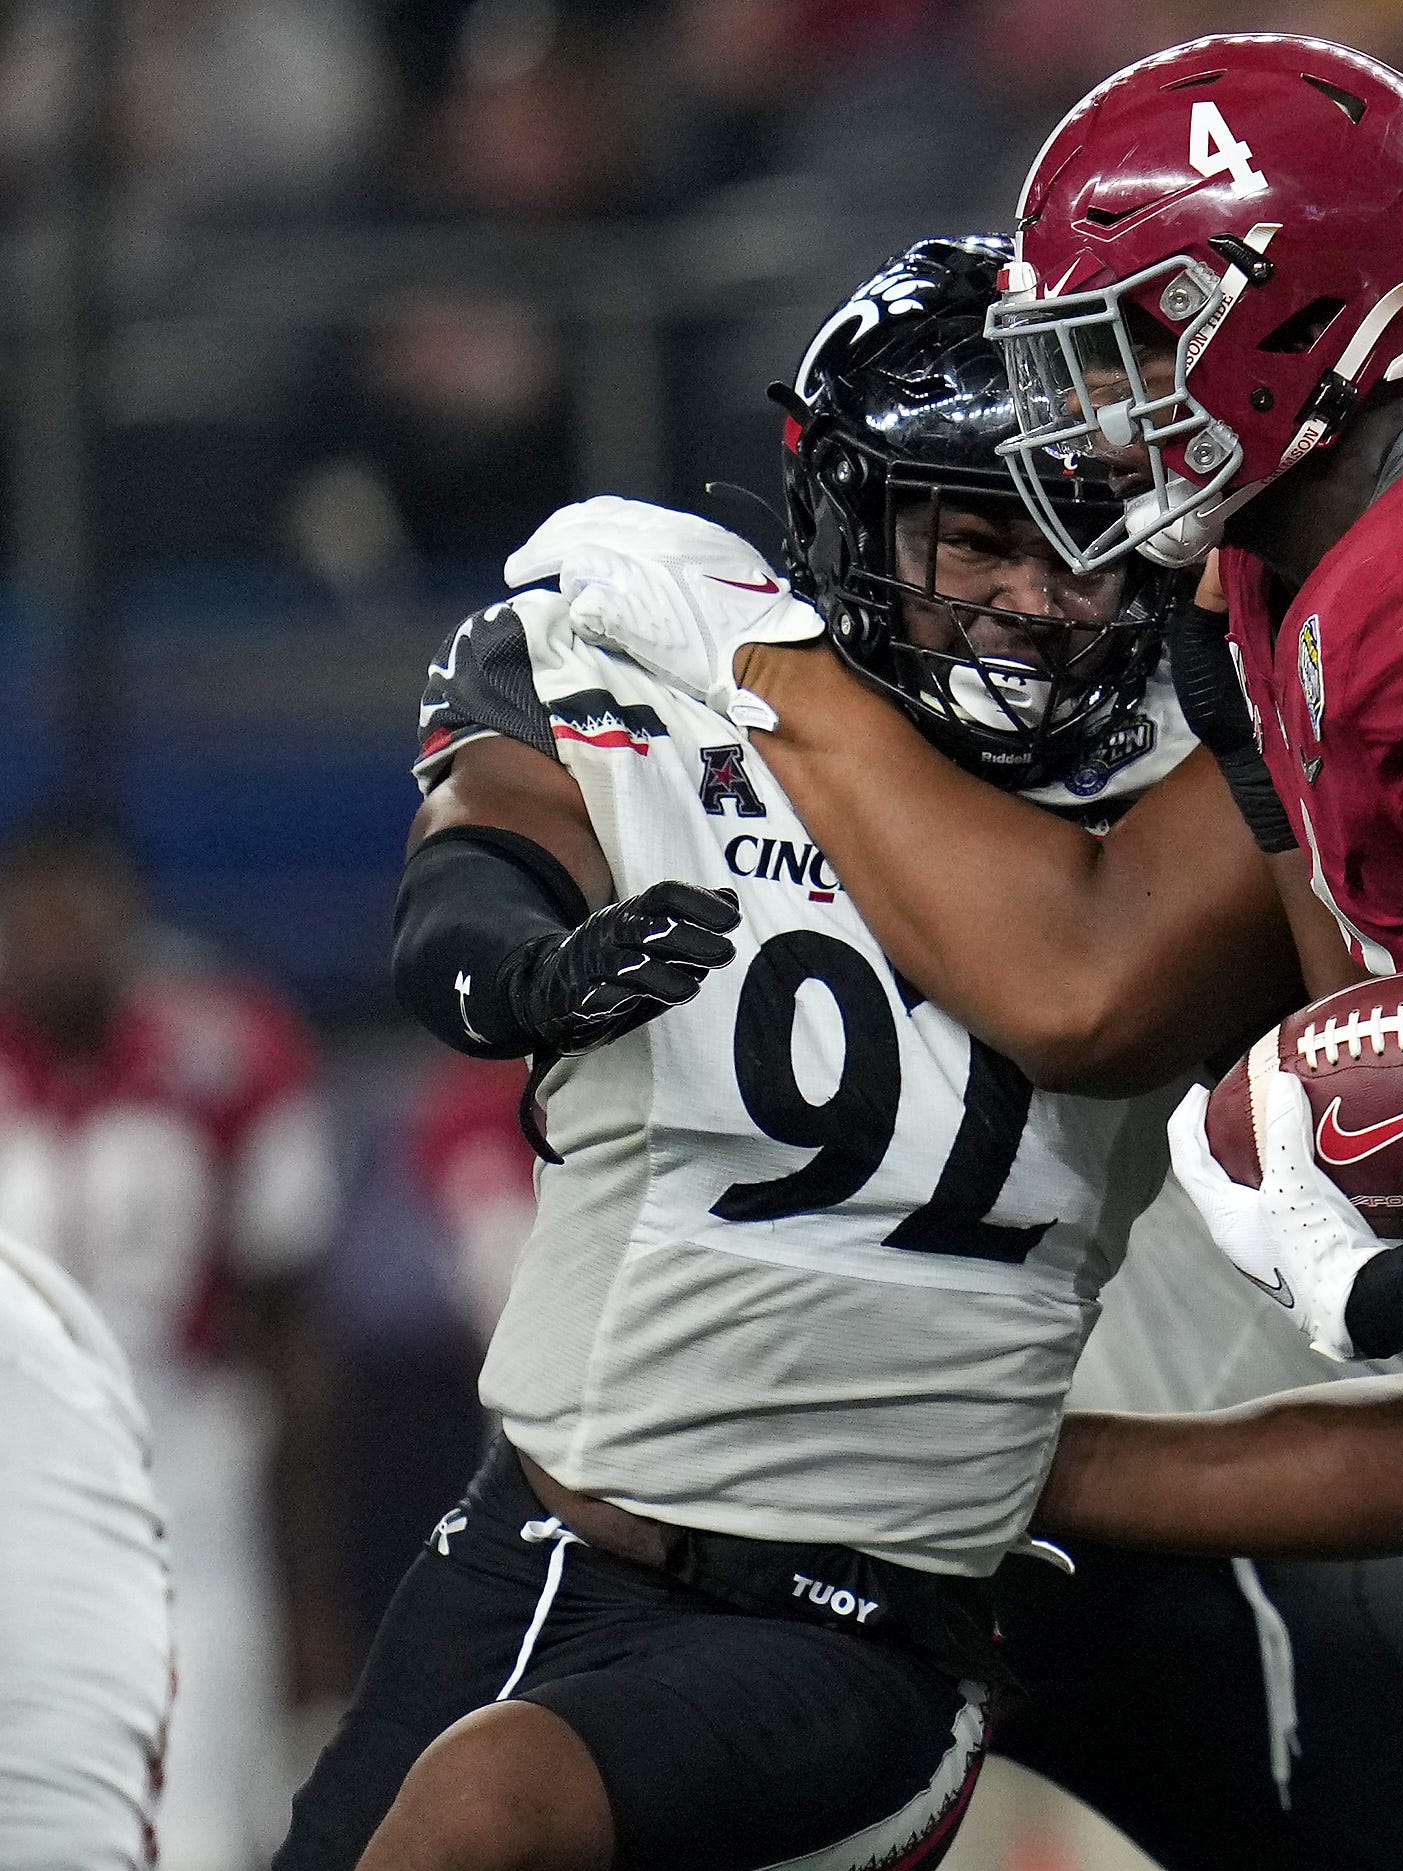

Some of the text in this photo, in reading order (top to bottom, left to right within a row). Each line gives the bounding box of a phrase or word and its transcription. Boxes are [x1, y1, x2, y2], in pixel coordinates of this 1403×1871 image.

[1188, 101, 1269, 200] 4
[981, 751, 1032, 765] Riddell
[724, 834, 846, 892] CINC
[709, 929, 1059, 1265] 92
[792, 1573, 879, 1624] TUOY
